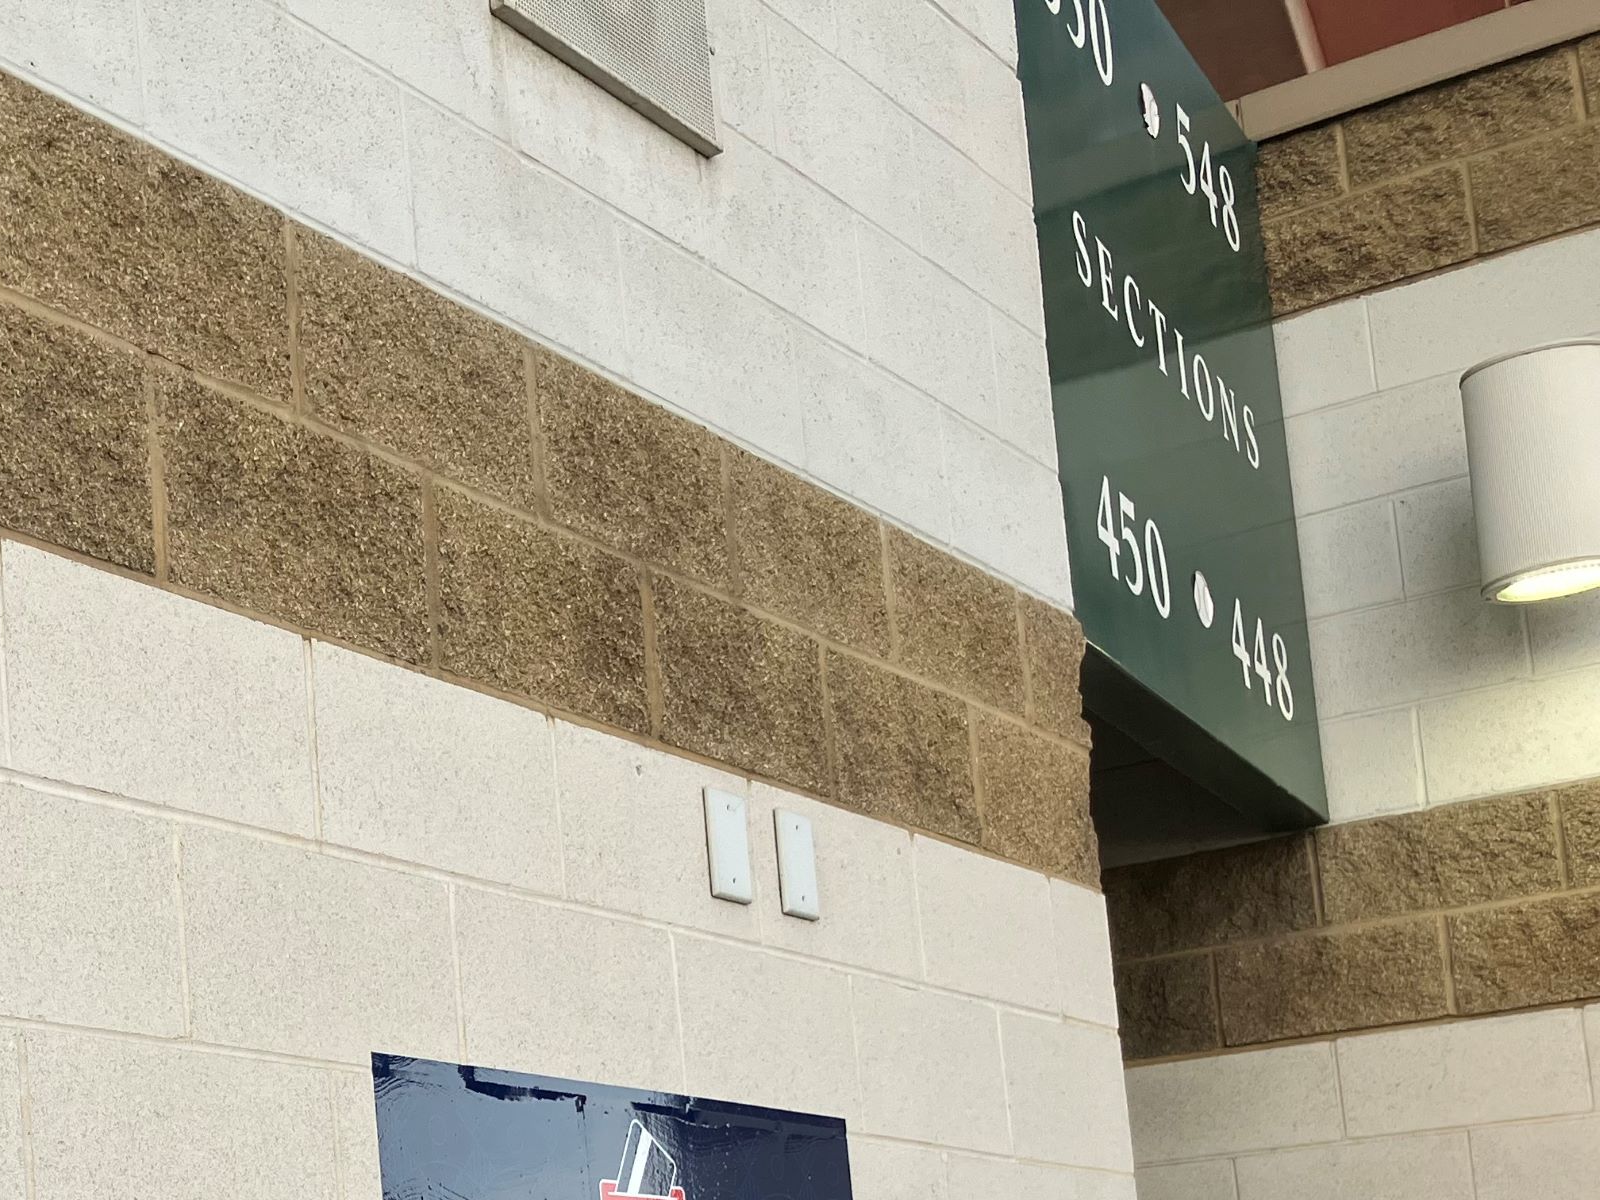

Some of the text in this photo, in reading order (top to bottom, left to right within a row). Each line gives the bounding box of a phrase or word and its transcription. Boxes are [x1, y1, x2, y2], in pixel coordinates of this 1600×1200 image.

[1176, 101, 1240, 252] 548
[1071, 210, 1260, 470] SECTIONS
[1096, 474, 1296, 722] 450 448
